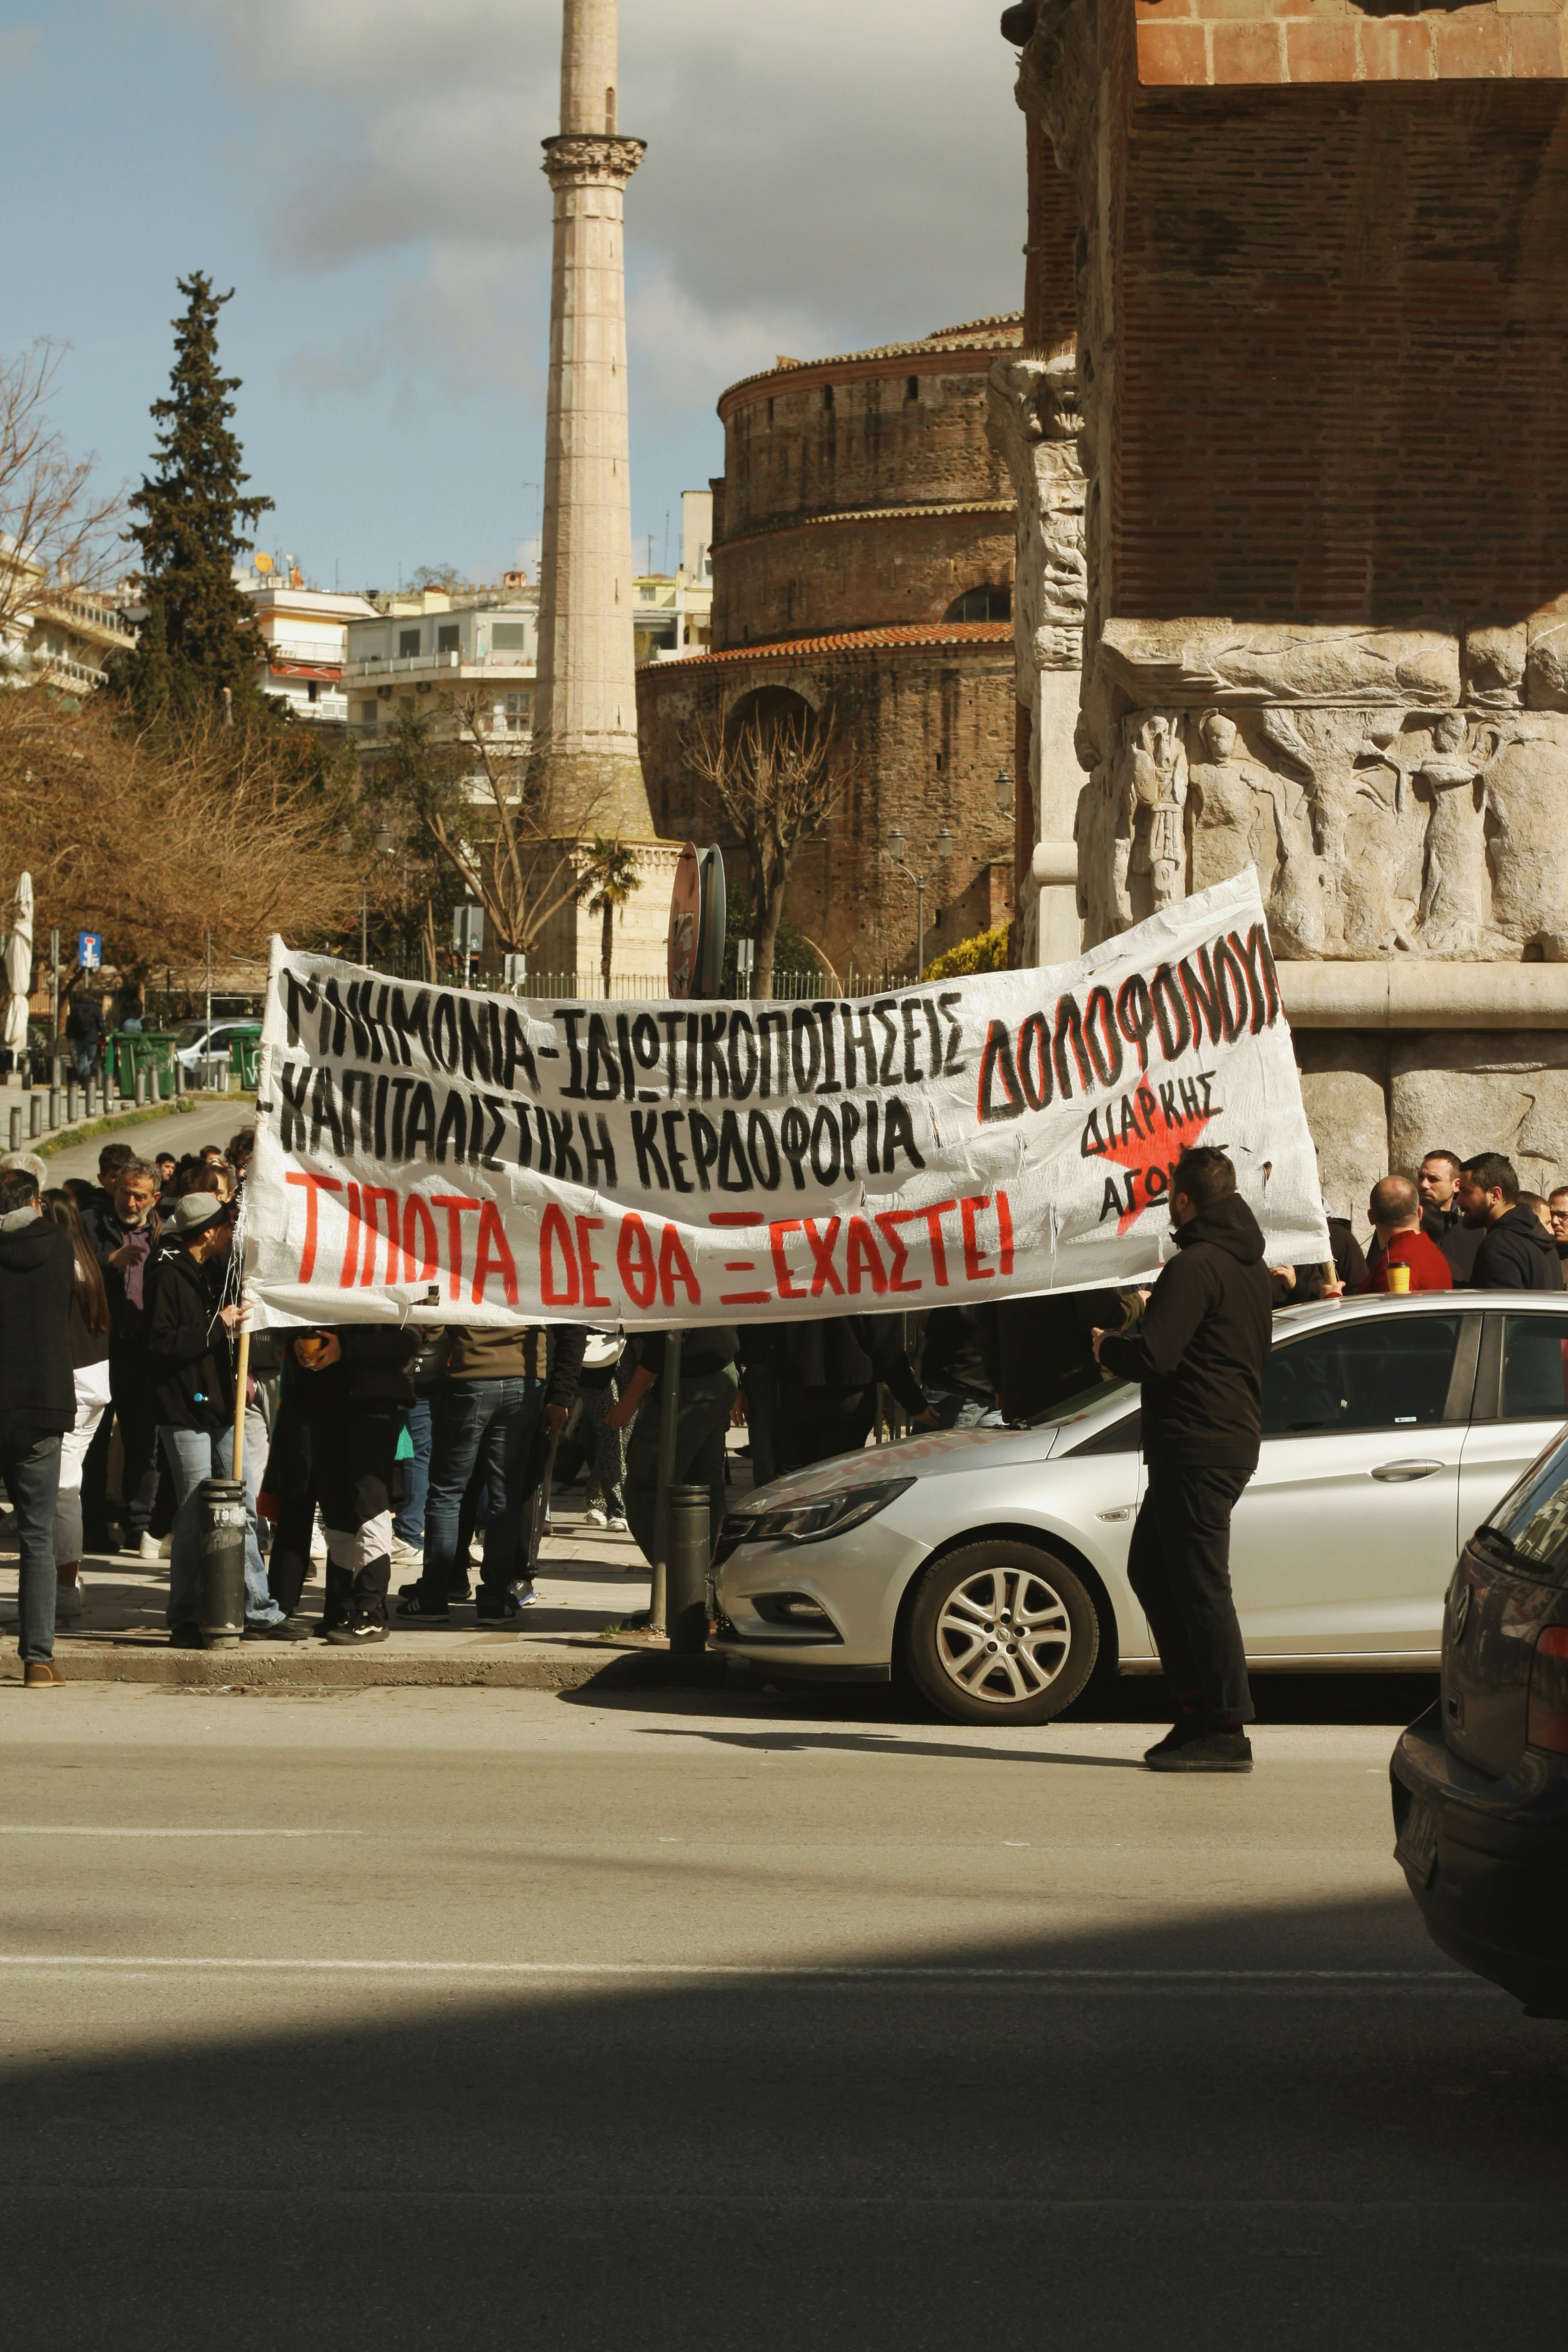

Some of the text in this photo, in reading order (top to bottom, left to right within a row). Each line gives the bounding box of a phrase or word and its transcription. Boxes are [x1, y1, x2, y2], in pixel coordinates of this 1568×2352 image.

[631, 1094, 926, 1193] ΚΕΡΔΟΦΟΡΙΑ
[1080, 1070, 1224, 1159] ΔΙΑΡΚΗΣ
[285, 1171, 1014, 1310] ΤΙΠΟΤΑ ΔΕ ΘΑ ΞΕΧΑΣΤΕΙ
